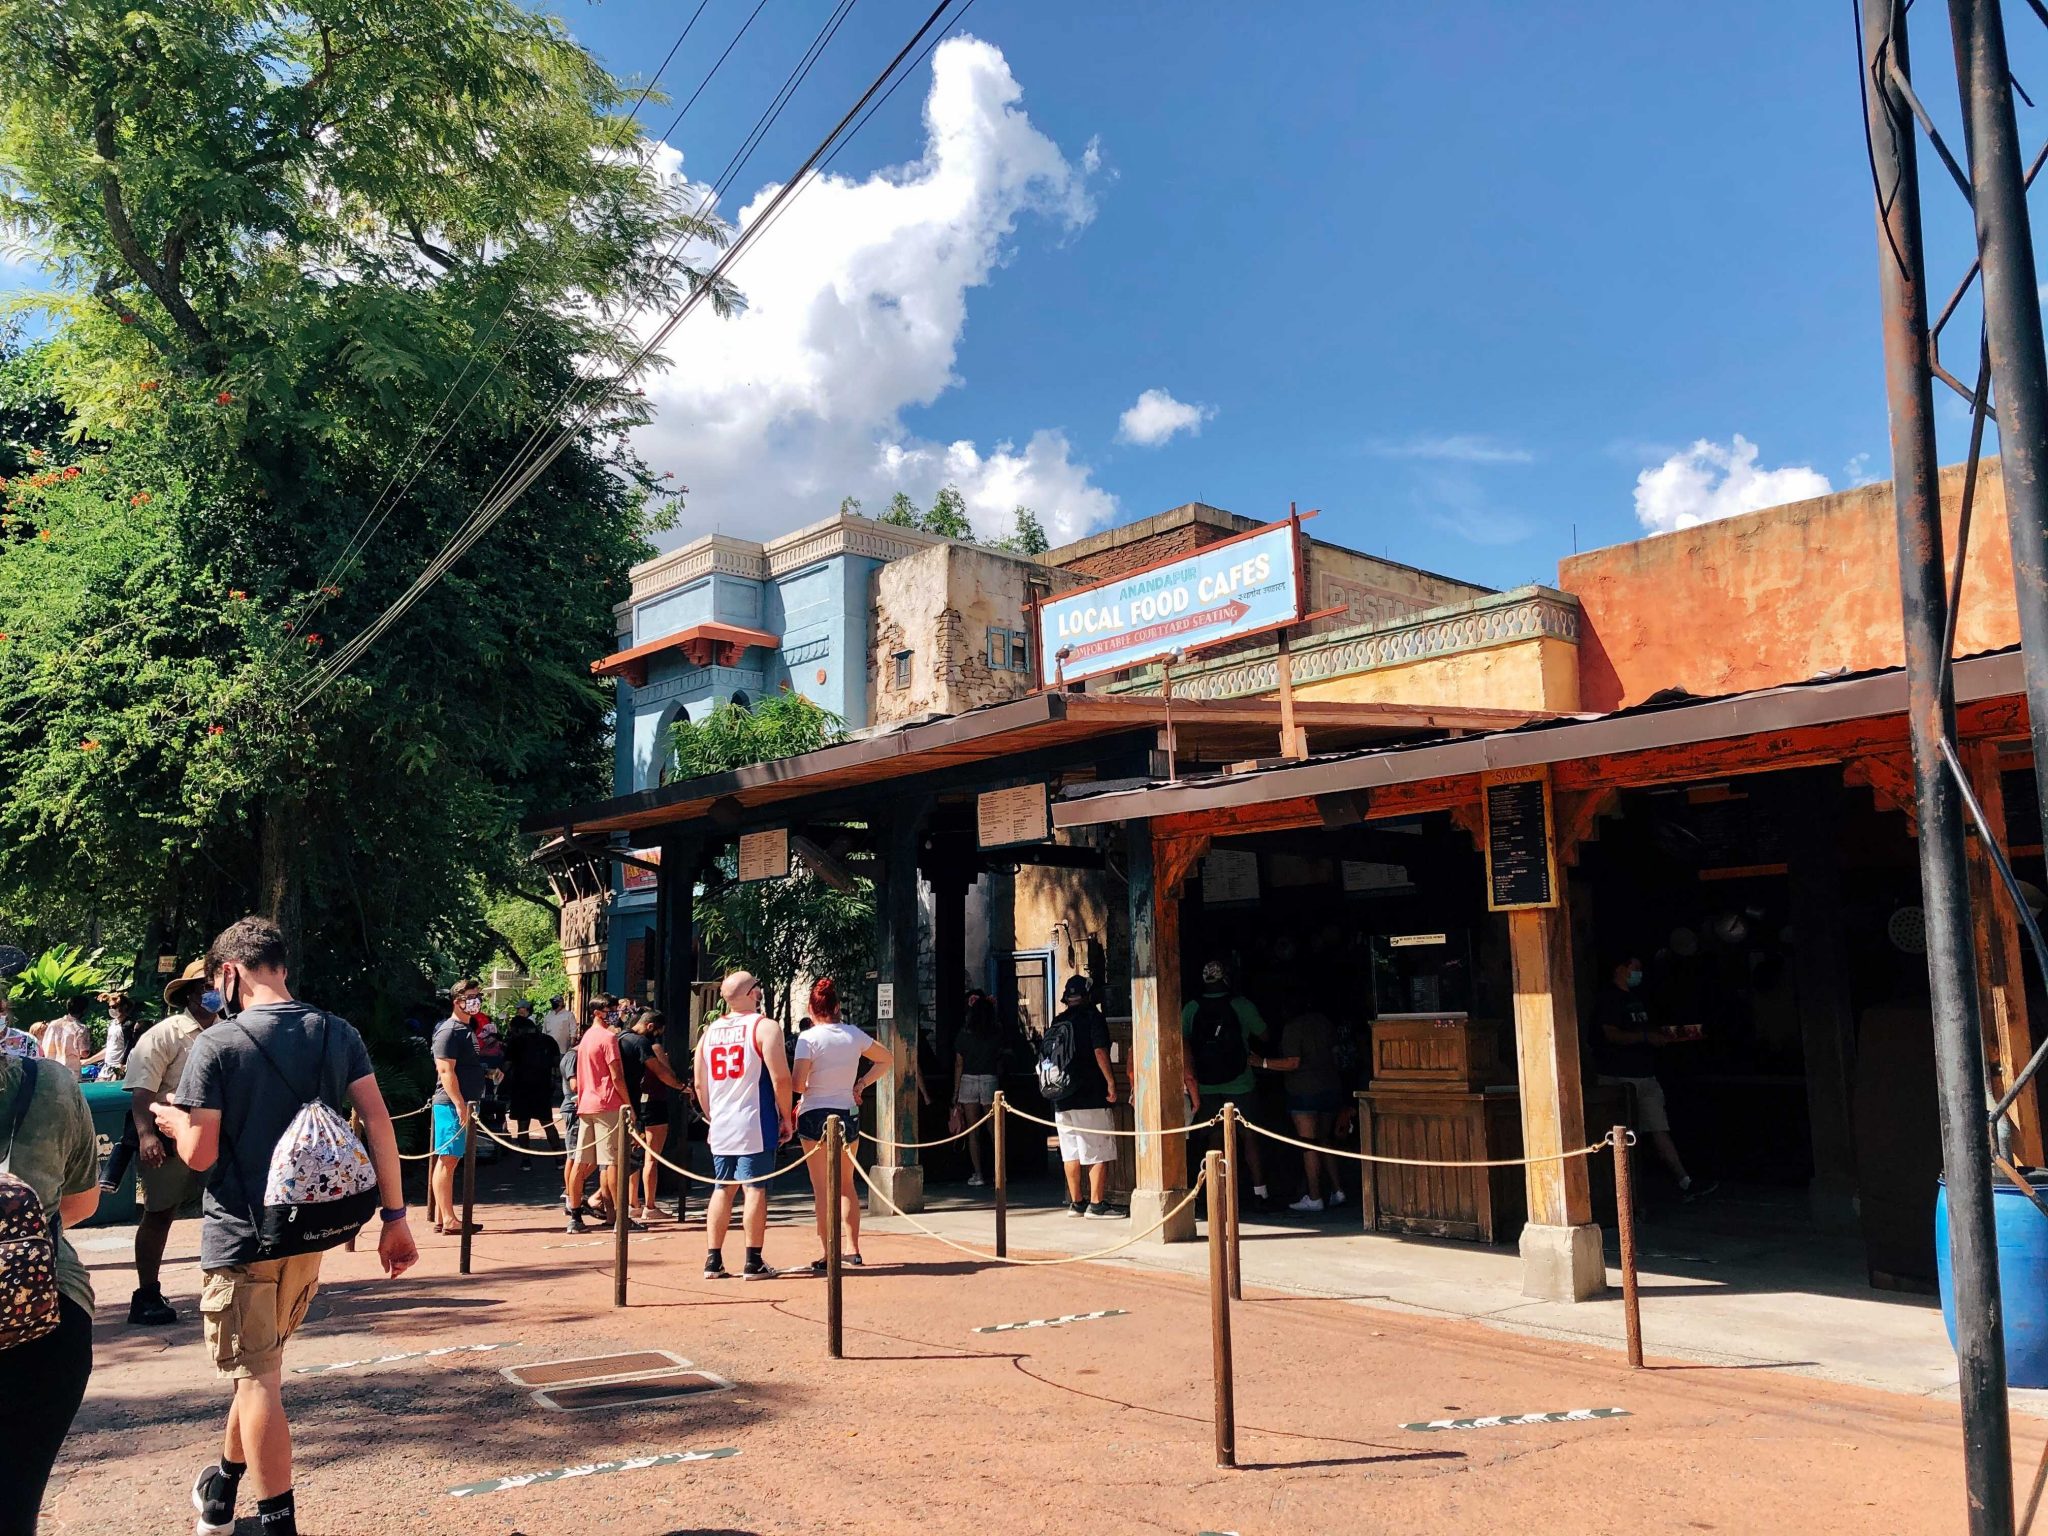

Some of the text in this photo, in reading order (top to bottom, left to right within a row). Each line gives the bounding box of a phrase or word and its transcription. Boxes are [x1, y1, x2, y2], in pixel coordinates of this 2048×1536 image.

[1058, 552, 1270, 637] LOCAL FOOD CAFES
[1120, 566, 1197, 600] ANANDAPUR
[1134, 619, 1190, 642] COURTYARD
[1192, 605, 1238, 625] SEATING
[711, 1045, 745, 1081] 63
